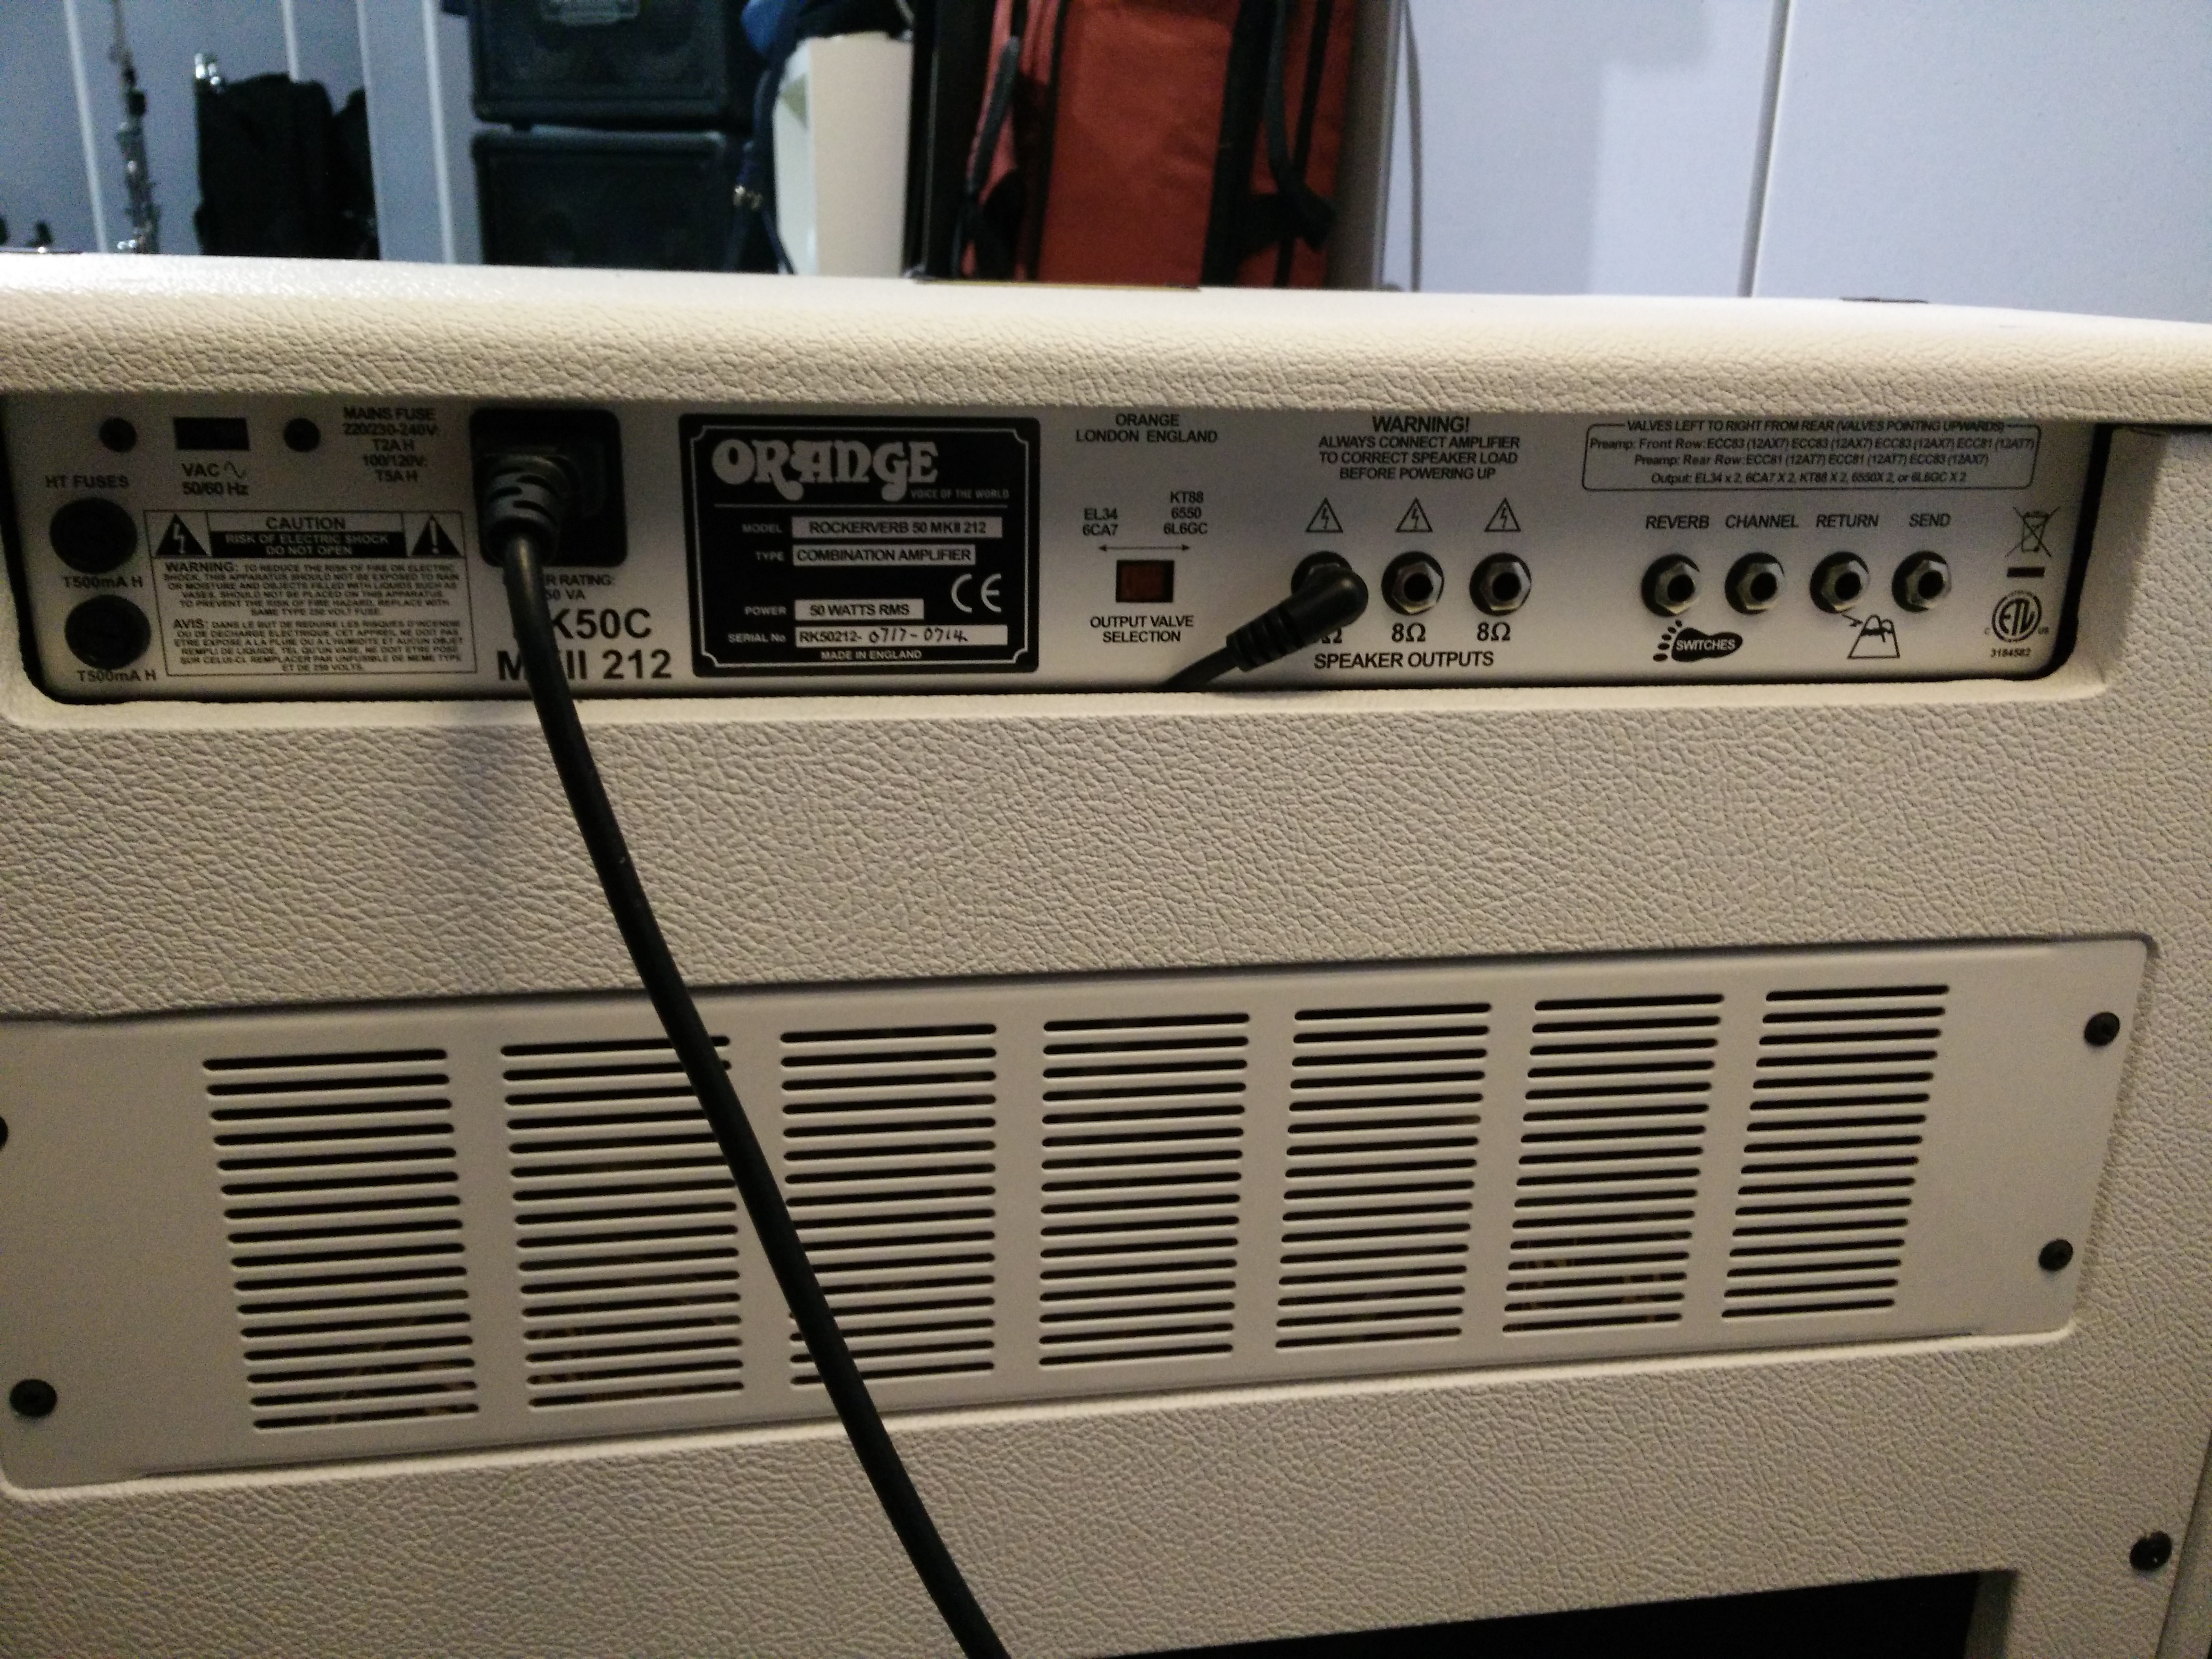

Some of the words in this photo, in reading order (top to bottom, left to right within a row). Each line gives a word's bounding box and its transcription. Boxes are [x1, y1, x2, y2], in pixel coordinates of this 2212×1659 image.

[343, 406, 392, 420] MAINS
[396, 407, 435, 420] FUSE
[1116, 413, 1180, 426] ORANGE
[1372, 415, 1470, 433] WARNING!
[1627, 420, 1672, 431] VALVES
[1675, 420, 1705, 431] LEFT
[1708, 420, 1723, 431] TO
[1726, 420, 1762, 431] RIGHT
[1764, 420, 1798, 431] FROM
[1802, 420, 1834, 431] REAR
[1837, 420, 1884, 433] (VALVES
[1887, 420, 1940, 432] POINTING
[1076, 429, 1139, 442] LONDON
[1146, 430, 1218, 443] ENGLAND
[1319, 435, 1376, 448] ALWAYS
[1379, 435, 1445, 449] CONNECT
[1449, 436, 1520, 449] AMPLIFIER
[373, 438, 401, 451] T2A
[403, 439, 415, 451] H
[1590, 438, 1635, 451] Preamp:
[1639, 438, 1672, 449] Front
[1747, 438, 1789, 451] (12AX7)
[1831, 438, 1872, 451] (12AX7)
[1319, 451, 1338, 464] TO
[1341, 451, 1408, 464] CORRECT
[1411, 451, 1477, 464] SPEAKER
[1480, 451, 1518, 464] LOAD
[1683, 454, 1711, 465] Rear
[181, 463, 220, 477] VAC
[406, 470, 418, 482] H
[712, 438, 939, 501] ORANGE
[1339, 467, 1395, 480] BEFORE
[1399, 467, 1473, 480] POWERING
[1477, 466, 1496, 479] UP
[45, 475, 66, 488] HT
[73, 475, 129, 488] FUSES
[1651, 472, 1691, 485] Output:
[1695, 472, 1722, 483] EL34
[1800, 472, 1828, 482] KT88
[1960, 472, 1966, 481] 2
[182, 481, 223, 496] 50/60
[227, 482, 249, 496] Hz
[911, 489, 937, 499] VOICE
[940, 489, 952, 499] OF
[956, 489, 972, 499] THE
[975, 489, 1009, 499] WORLD
[1170, 490, 1204, 503] KT88
[1084, 507, 1118, 520] EL34
[1171, 506, 1202, 519] 6550
[266, 516, 346, 530] CAUTION
[742, 524, 782, 533] MODEL
[809, 521, 908, 534] ROCKERVERB
[912, 522, 927, 533] 50
[964, 522, 986, 533] 212
[1163, 522, 1208, 534] 6L6GC
[1646, 515, 1710, 530] REVERB
[1725, 514, 1799, 529] CHANNEL
[1815, 514, 1878, 527] RETURN
[1909, 513, 1951, 527] SEND
[1083, 523, 1119, 536] 6CA7
[225, 533, 255, 543] RISK
[258, 533, 275, 543] OF
[280, 534, 341, 544] ELECTRIC
[345, 534, 389, 544] SHOCK
[266, 545, 285, 556] DO
[288, 545, 313, 556] NOT
[317, 545, 353, 556] OPEN
[755, 551, 784, 562] TYPE
[797, 549, 895, 561] COMBINATION
[899, 549, 971, 561] AMPLIFIER
[165, 562, 238, 572] WARNING:
[63, 576, 128, 589] T500mA
[131, 576, 143, 588] H
[566, 589, 585, 600] VA
[951, 573, 1001, 613] CE
[744, 606, 786, 615] POWER
[810, 605, 824, 616] 50
[828, 604, 876, 616] WATTS
[879, 604, 909, 615] RMS
[551, 608, 652, 639] K50C
[1090, 615, 1149, 629] OUTPUT
[1151, 615, 1194, 628] VALVE
[728, 633, 768, 643] SERIAL
[1103, 630, 1181, 643] SELECTION
[1391, 622, 1426, 642] 8Ω
[1477, 622, 1511, 641] 8Ω
[1676, 639, 1736, 651] SWITCHES
[820, 651, 852, 660] MADE
[856, 651, 866, 660] IN
[869, 650, 921, 660] ENGLAND
[1314, 652, 1403, 669] SPEAKER
[1408, 650, 1494, 668] OUTPUTS
[497, 649, 588, 680] MII
[602, 649, 672, 679] 212
[77, 669, 141, 682] T500mA
[145, 669, 156, 681] H
